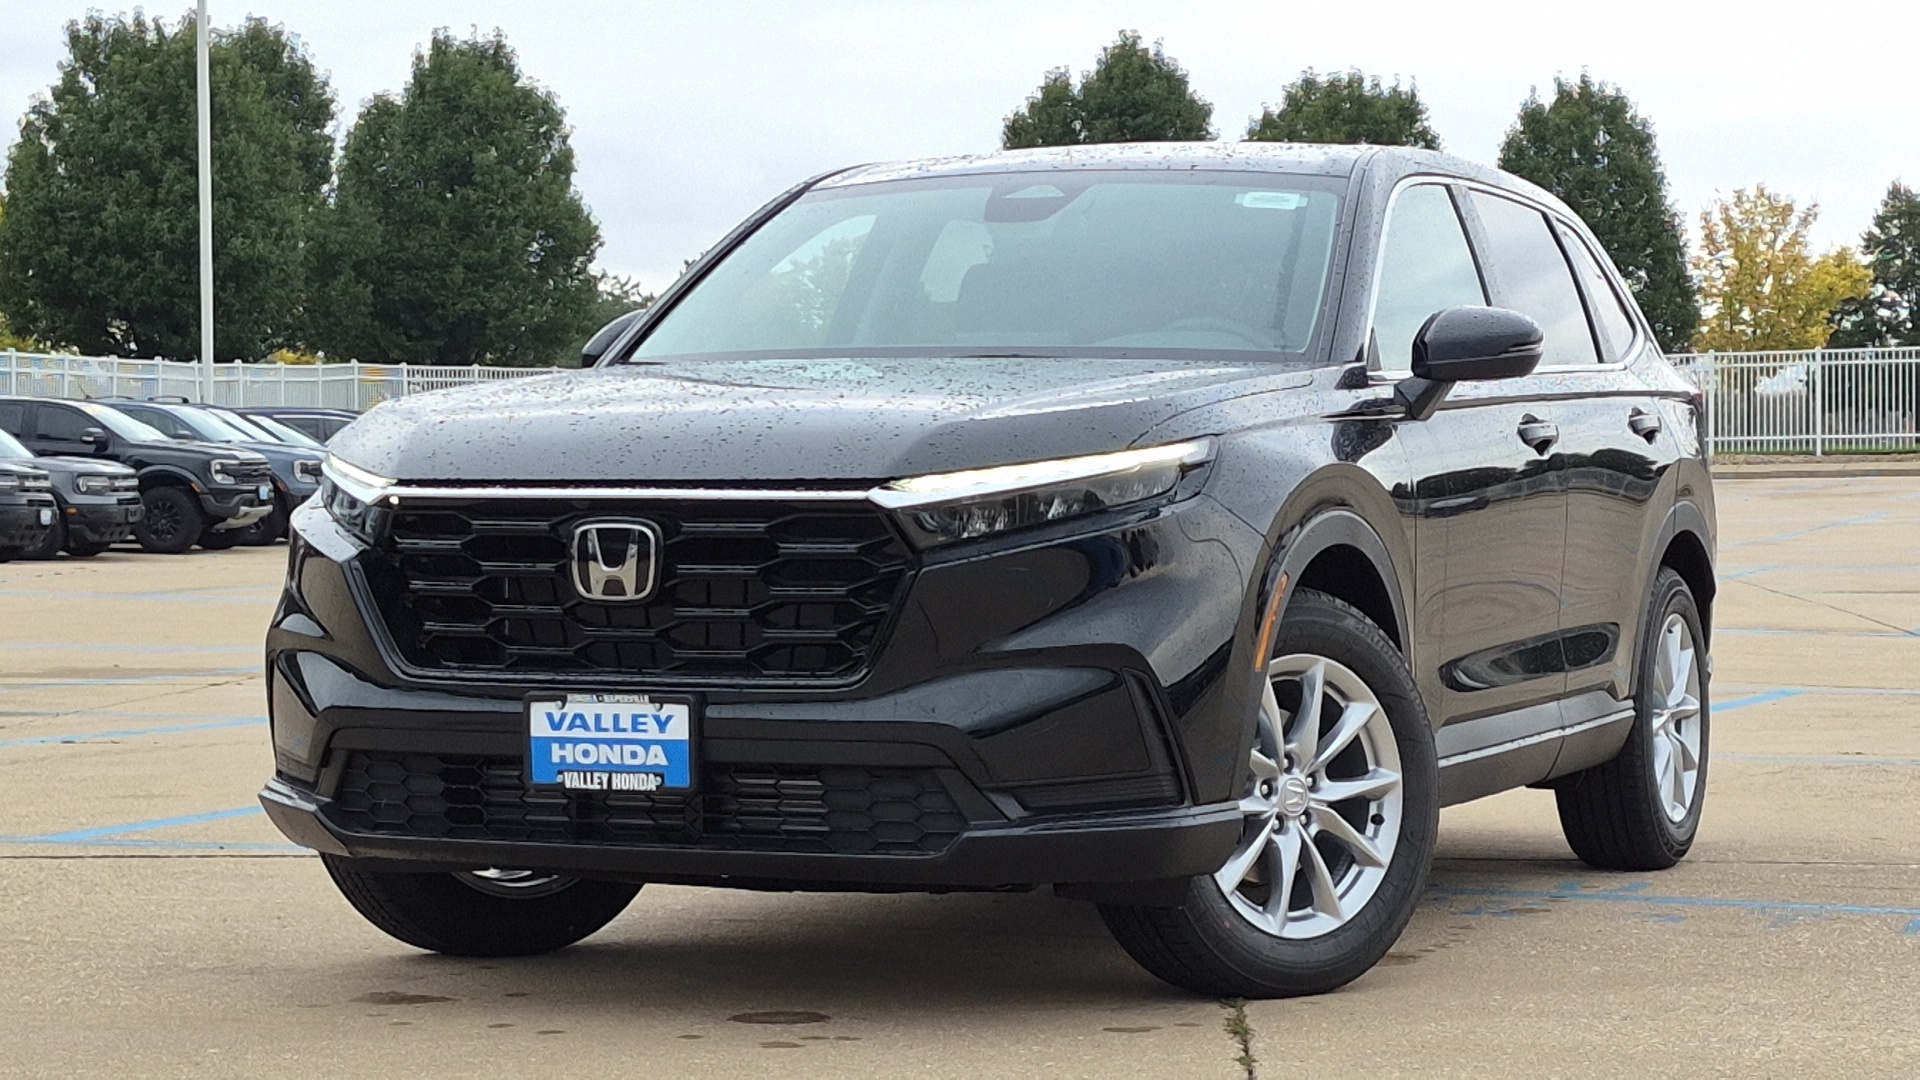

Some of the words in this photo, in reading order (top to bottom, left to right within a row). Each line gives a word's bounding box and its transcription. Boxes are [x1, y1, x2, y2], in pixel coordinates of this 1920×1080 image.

[545, 712, 675, 734] VALLEY
[551, 743, 669, 766] HONDA
[564, 771, 609, 790] VALLEY
[611, 772, 657, 791] HONDA
